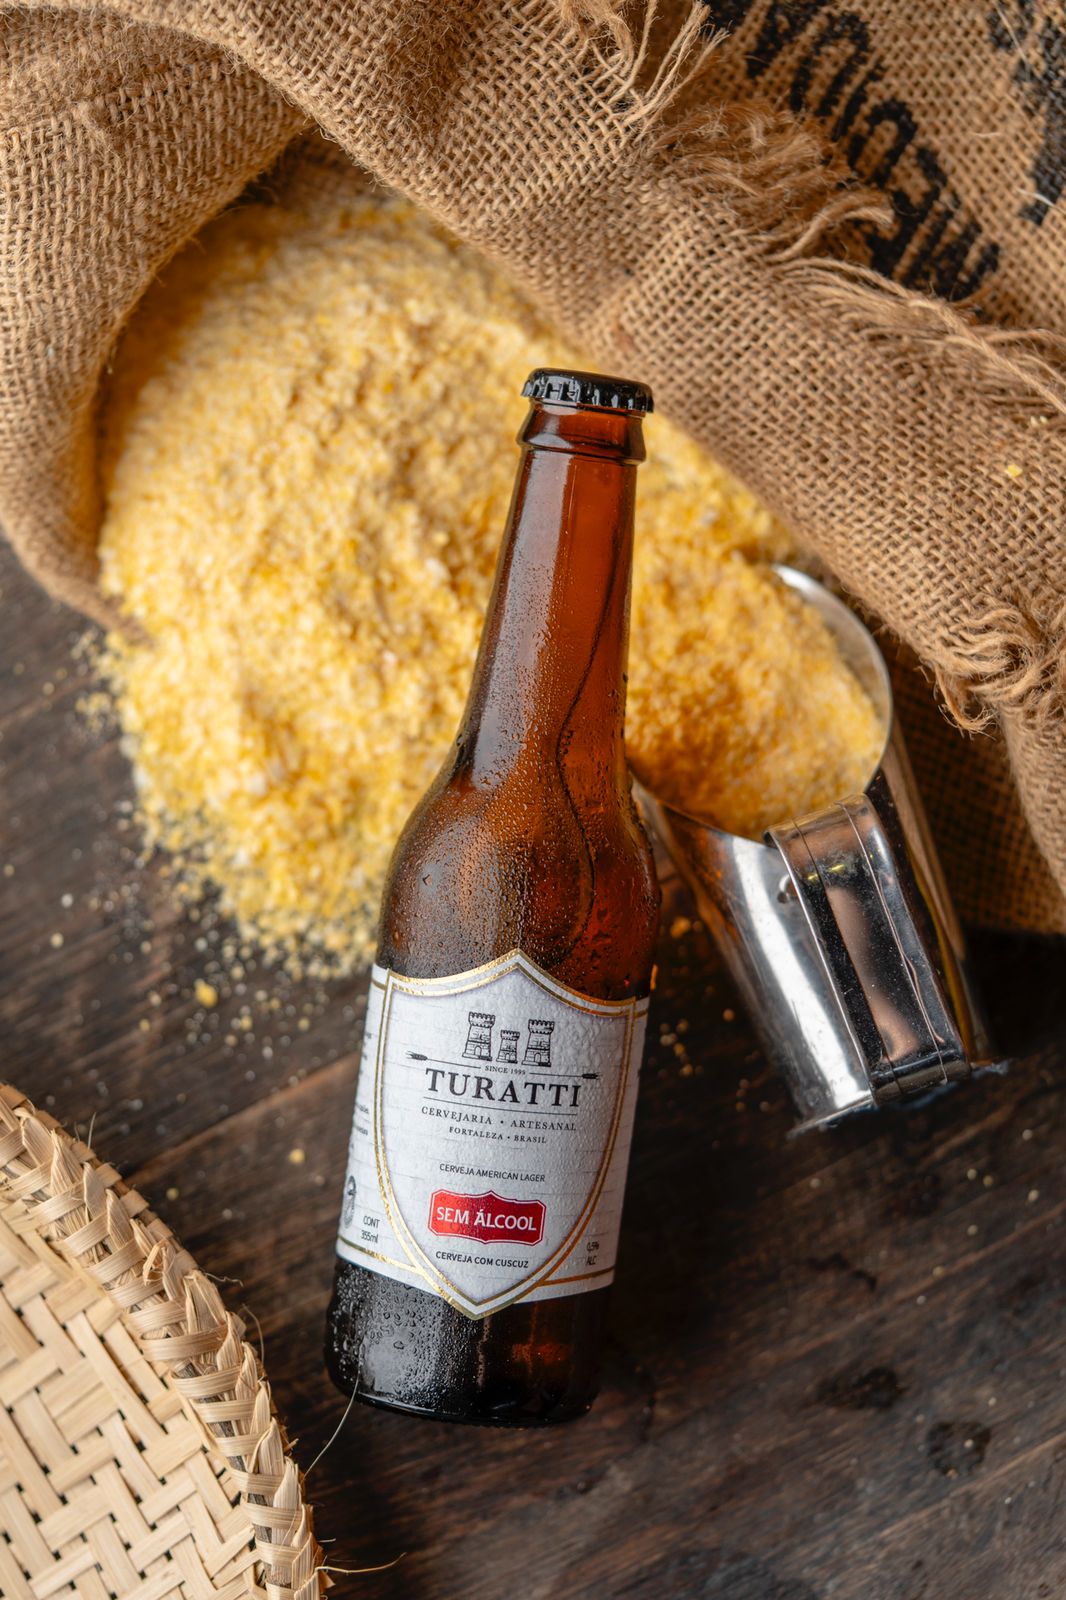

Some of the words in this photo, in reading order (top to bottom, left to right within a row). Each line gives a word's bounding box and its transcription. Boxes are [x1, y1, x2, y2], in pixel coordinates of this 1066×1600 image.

[484, 1065, 508, 1074] SINCE
[425, 1067, 581, 1107] TURATTI
[421, 1106, 492, 1125] CERVEJARIA
[510, 1119, 577, 1132] ARTESANAL
[449, 1126, 503, 1140] FORTALEZA
[513, 1135, 547, 1144] BRASIL
[439, 1163, 474, 1176] CERVEJA
[475, 1169, 519, 1181] AMERICAN
[520, 1174, 546, 1183] LAGER
[363, 1215, 380, 1229] CONT
[436, 1206, 469, 1225] SEM
[474, 1208, 537, 1231] ÁLCOOL
[361, 1229, 379, 1244] 355ml
[435, 1251, 473, 1264] CERVEJA
[474, 1256, 493, 1266] COM
[495, 1258, 529, 1269] CUSCUZ
